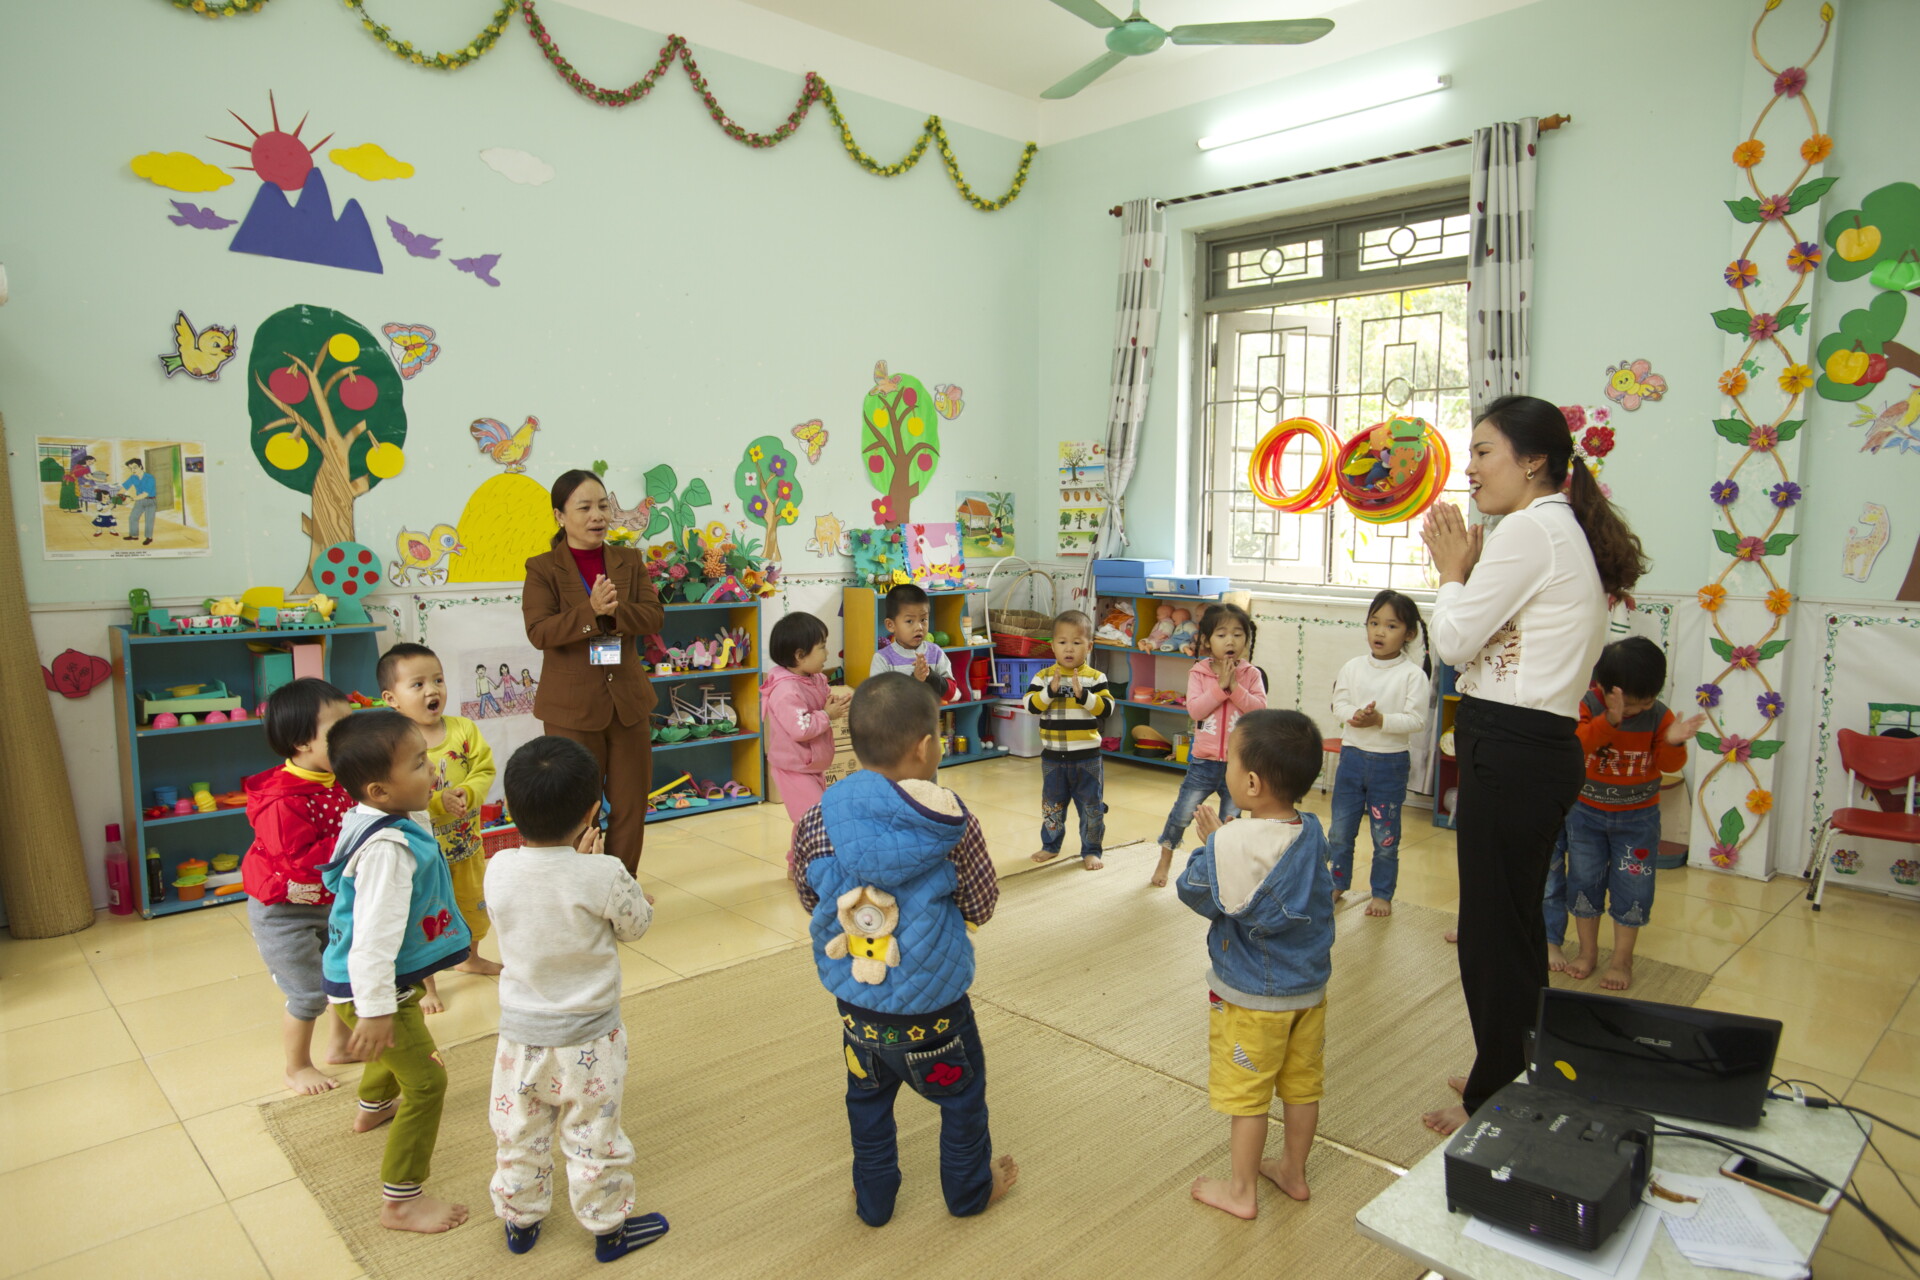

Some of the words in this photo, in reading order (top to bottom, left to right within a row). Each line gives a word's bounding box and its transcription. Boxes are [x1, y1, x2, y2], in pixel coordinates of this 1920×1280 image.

[1618, 859, 1653, 877] Books
[443, 928, 460, 940] Dog
[1633, 1036, 1672, 1048] ASUS
